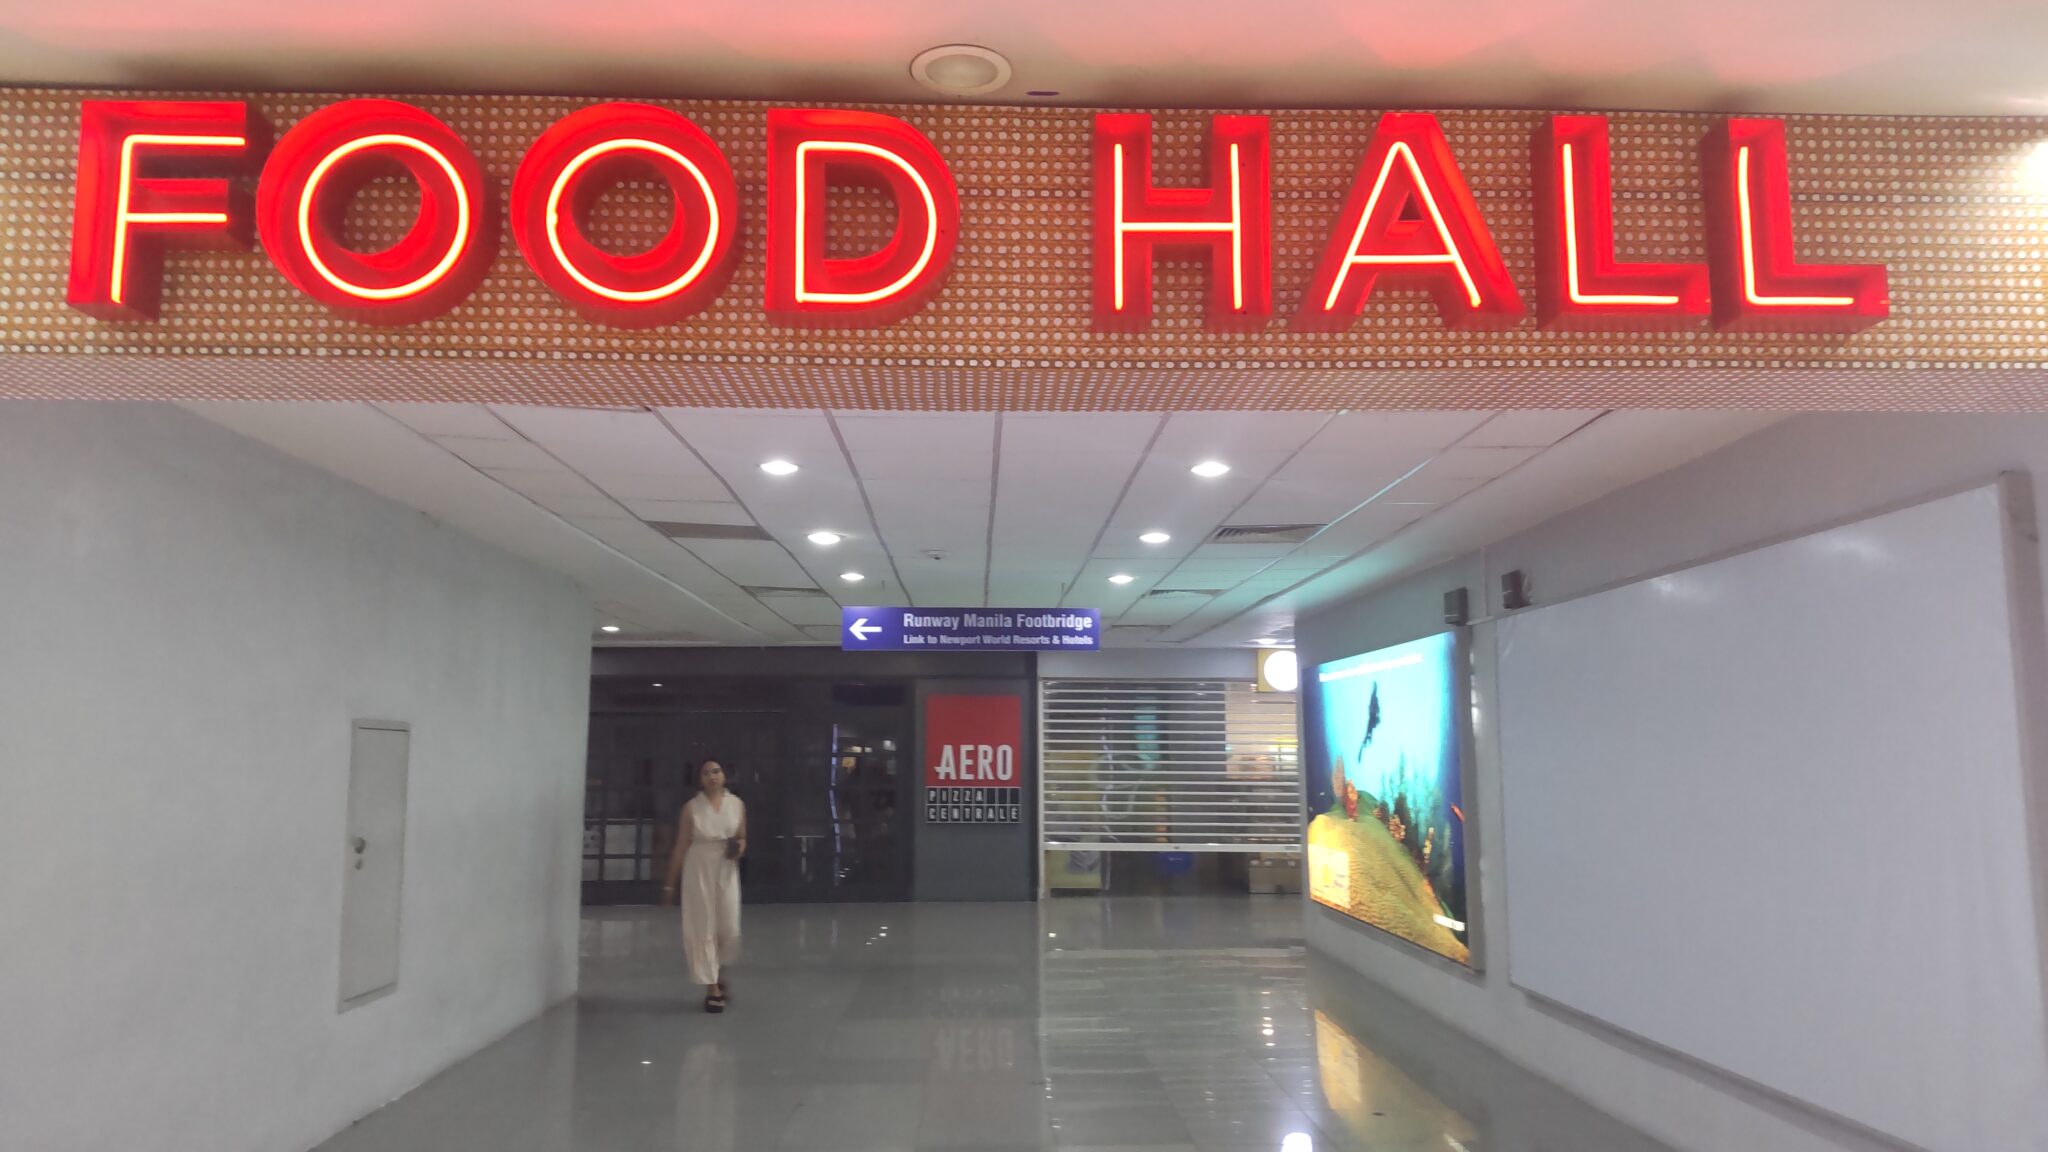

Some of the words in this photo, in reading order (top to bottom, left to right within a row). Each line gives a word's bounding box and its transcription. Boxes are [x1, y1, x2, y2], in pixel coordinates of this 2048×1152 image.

[68, 97, 960, 327] FOOD
[1093, 112, 1889, 332] HALL
[903, 613, 960, 630] Runway
[963, 613, 1013, 628] Manila
[1016, 614, 1093, 631] Footbridge
[903, 635, 925, 644] Link
[927, 635, 938, 644] to
[939, 635, 981, 646] Newport
[982, 635, 1011, 644] World
[1013, 635, 1050, 644] Resorts
[1052, 635, 1061, 644] &
[1062, 635, 1094, 645] Hotels
[934, 744, 1014, 781] AERO
[928, 790, 984, 802] PIZZA
[928, 807, 1019, 820] CENTRALE
